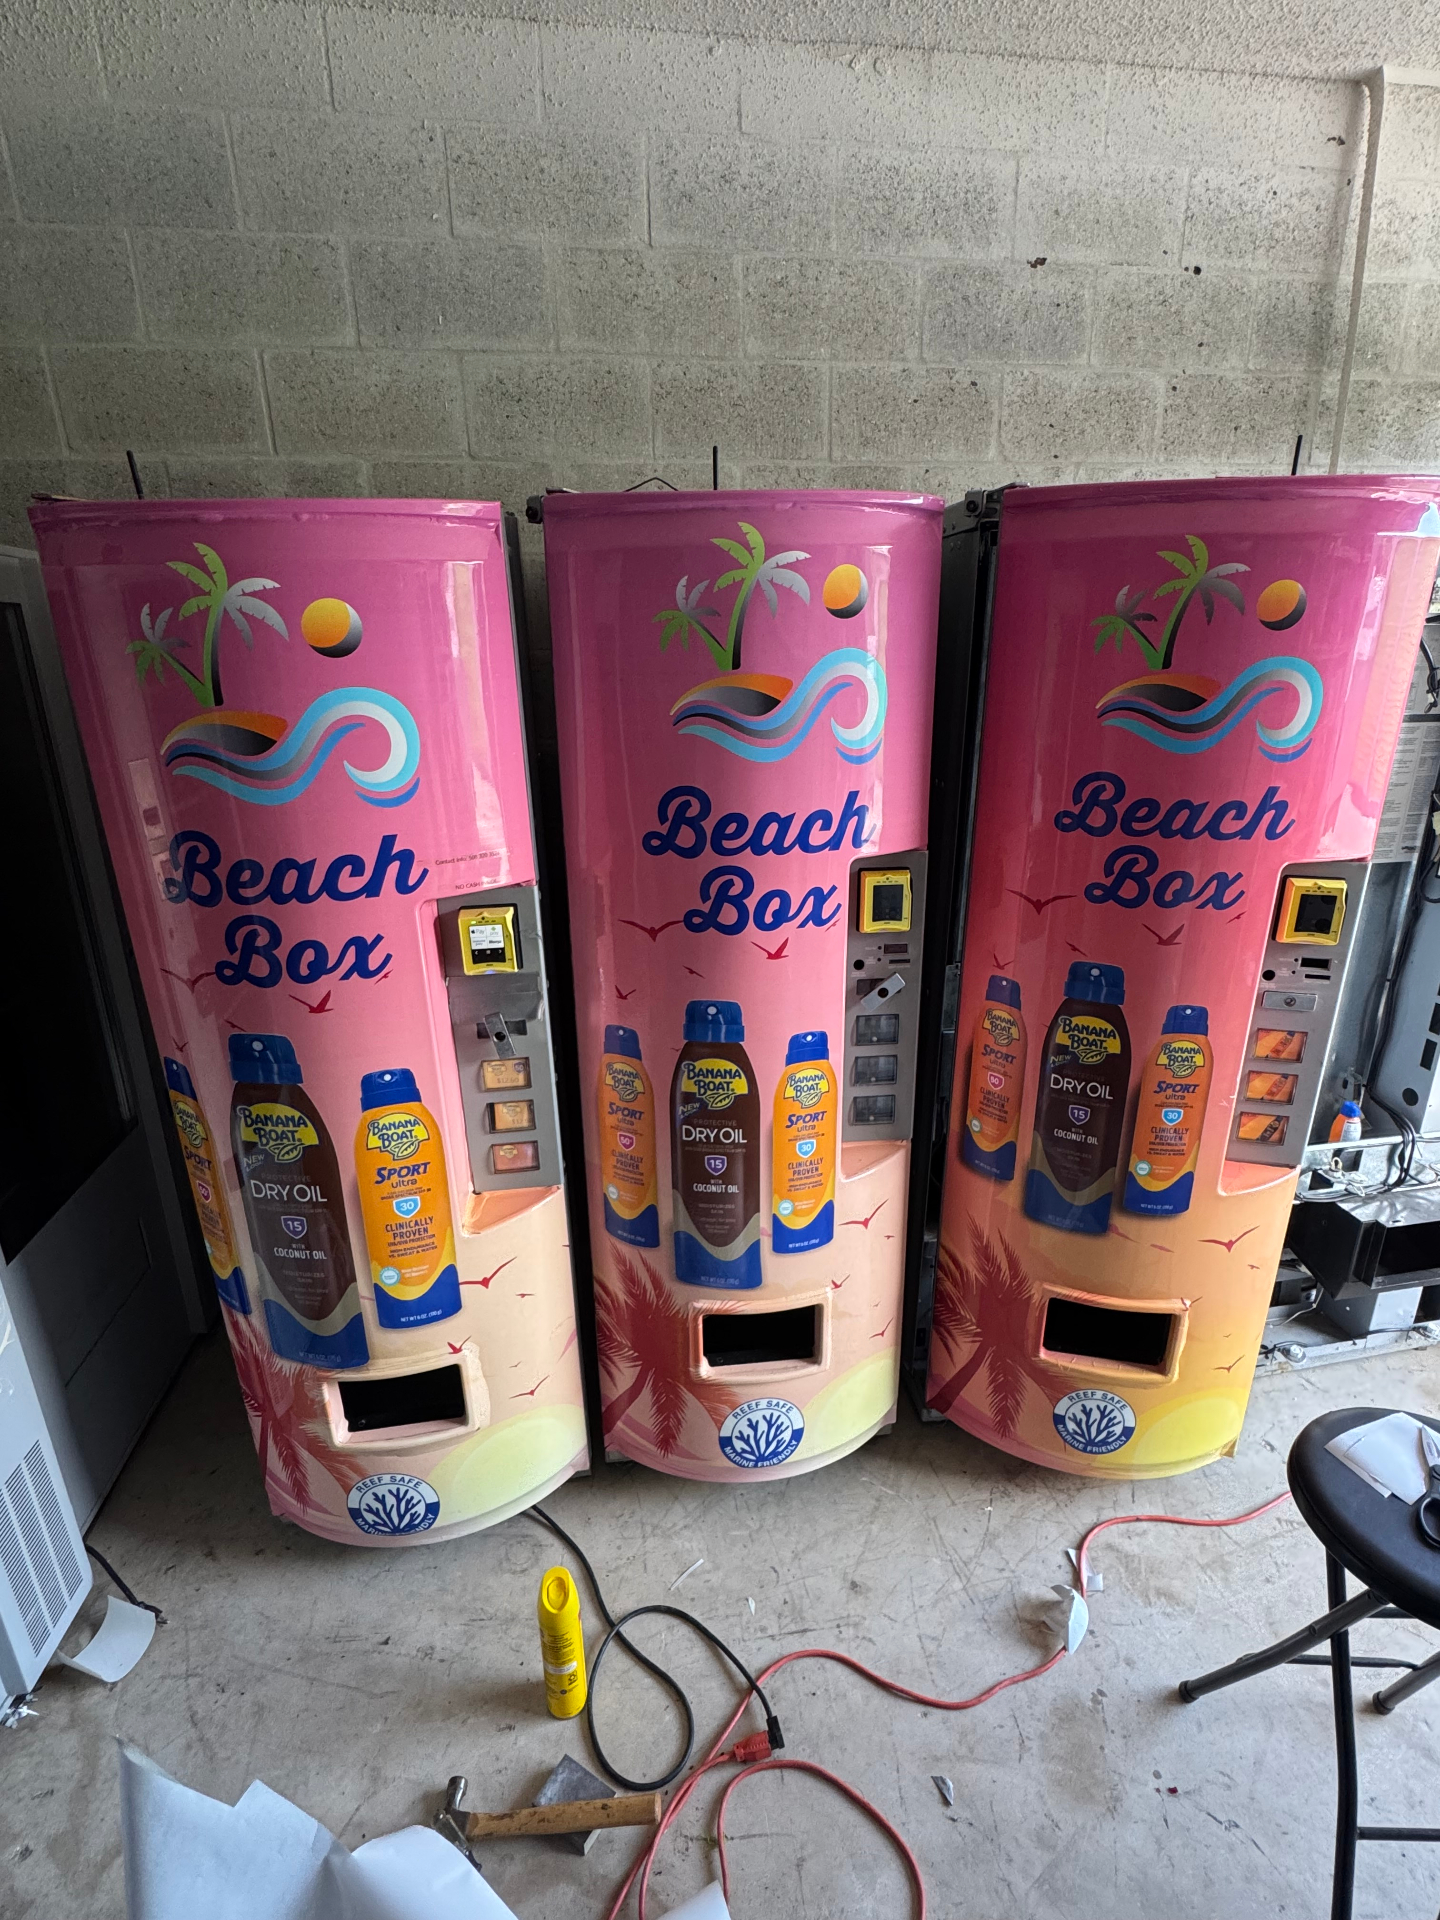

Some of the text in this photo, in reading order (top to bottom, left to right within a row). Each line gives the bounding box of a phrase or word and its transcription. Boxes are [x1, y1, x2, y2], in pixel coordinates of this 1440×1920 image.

[1054, 771, 1295, 840] Beach
[642, 785, 877, 859] Beach
[435, 857, 455, 865] Contact
[164, 830, 429, 908] Beach
[1083, 844, 1245, 910] Box
[466, 881, 479, 889] CASH
[683, 865, 843, 936] Box
[216, 914, 392, 989] Box
[987, 1009, 1017, 1028] BANANA
[1059, 1016, 1117, 1040] BANANA
[981, 1043, 1017, 1064] SPORT
[1162, 1043, 1202, 1055] BANANA
[1050, 1055, 1072, 1064] NEW
[607, 1062, 639, 1079] BANANA
[683, 1062, 742, 1080] BANANA
[788, 1074, 825, 1087] BANANA
[1050, 1073, 1114, 1099] DRY OIL
[1153, 1081, 1200, 1094] SPORT
[980, 1086, 1010, 1102] CLINICALLY
[1165, 1093, 1186, 1101] ultra
[678, 1102, 700, 1115] NEW
[982, 1095, 1006, 1109] PROVEN
[237, 1106, 308, 1128] BANANA
[608, 1102, 644, 1120] SPORT
[1073, 1109, 1085, 1119] 15
[1166, 1112, 1178, 1120] 30
[370, 1118, 421, 1136] BANANA
[617, 1117, 635, 1126] ultra
[785, 1110, 827, 1129] SPORT
[682, 1125, 748, 1143] DRY OIL
[797, 1124, 816, 1132] ultra
[1150, 1127, 1190, 1135] CLINICALLY
[1054, 1128, 1099, 1145] COCONUT OIL
[1154, 1134, 1183, 1142] PROVEN
[801, 1144, 812, 1152] 30
[243, 1154, 265, 1167] NEW
[612, 1149, 644, 1164] CLINICALLY
[616, 1158, 640, 1170] PROVEN
[709, 1159, 722, 1169] 15
[788, 1157, 824, 1170] CLINICALLY
[374, 1161, 431, 1185] SPORT
[792, 1166, 819, 1177] PROVEN
[250, 1179, 328, 1202] DRY OIL
[391, 1178, 418, 1188] ultra
[693, 1183, 740, 1193] COCONUT OIL
[400, 1201, 414, 1211] 30
[287, 1221, 302, 1232] 15
[385, 1216, 434, 1233] CLINICALLY
[393, 1226, 429, 1240] PROVEN
[273, 1247, 328, 1260] COCONUT OIL
[1067, 1391, 1128, 1411] REEF SAFE
[732, 1400, 794, 1419] REEF SAFE
[1056, 1424, 1127, 1453] MARINE FRIENDLY
[723, 1439, 798, 1468] MARINE FRIENDLY
[356, 1475, 423, 1493] REEF SAFE
